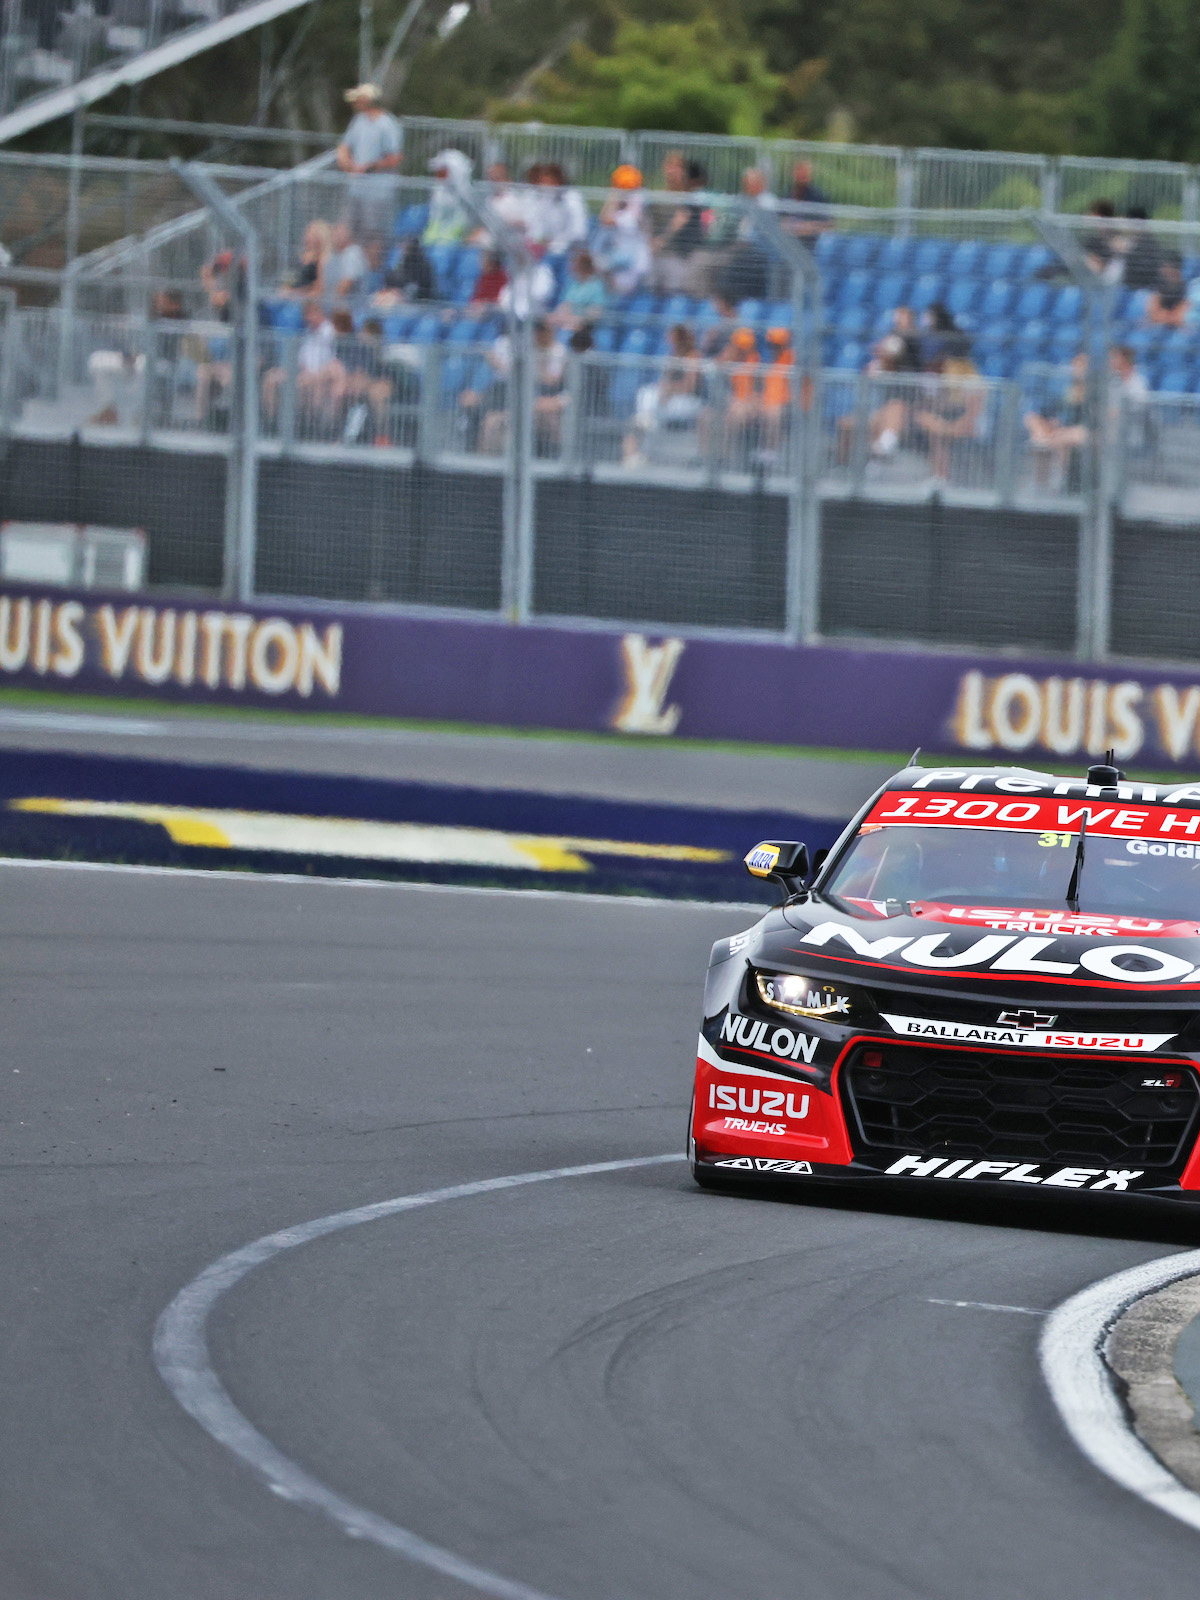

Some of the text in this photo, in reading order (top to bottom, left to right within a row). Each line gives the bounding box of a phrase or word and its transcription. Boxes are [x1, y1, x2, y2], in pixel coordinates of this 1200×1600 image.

[0, 596, 343, 697] UIS VUITTON
[957, 669, 1144, 761] LOUIS
[880, 797, 1041, 822] 1300
[1057, 805, 1149, 831] WE
[1037, 833, 1072, 848] 31
[749, 851, 774, 869] NAPA
[949, 907, 1163, 932] ISUZU
[720, 1012, 820, 1063] NULON
[907, 1022, 1143, 1048] BALLARAT ISUZU
[709, 1083, 810, 1119] ISUZU
[724, 1116, 787, 1135] TRUCKS
[883, 1154, 1145, 1191] HIFLEX
